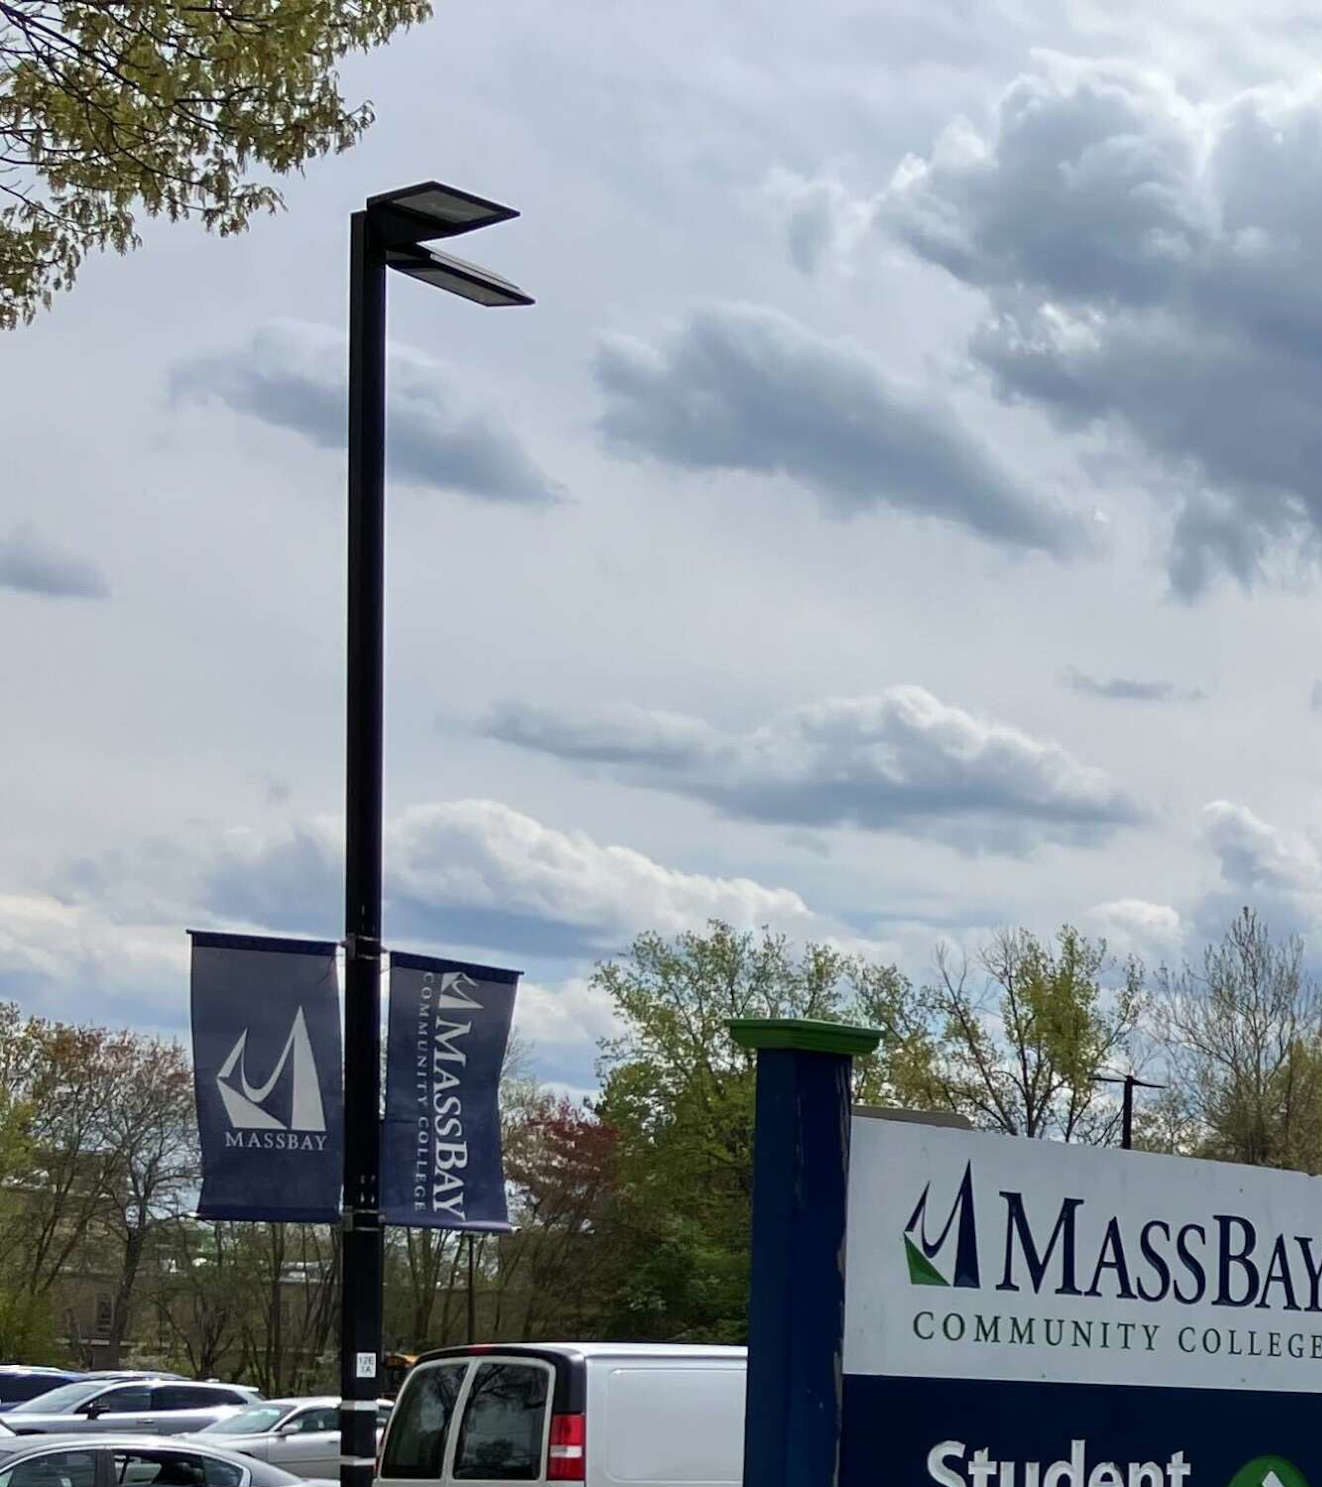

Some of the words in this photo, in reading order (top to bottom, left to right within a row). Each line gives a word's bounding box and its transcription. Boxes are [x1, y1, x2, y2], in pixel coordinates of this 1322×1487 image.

[416, 970, 433, 1107] COMMUNITY
[224, 1130, 328, 1152] MASSBAY
[413, 1117, 429, 1213] COLLEGE
[912, 1310, 1161, 1352] COMMUNITY
